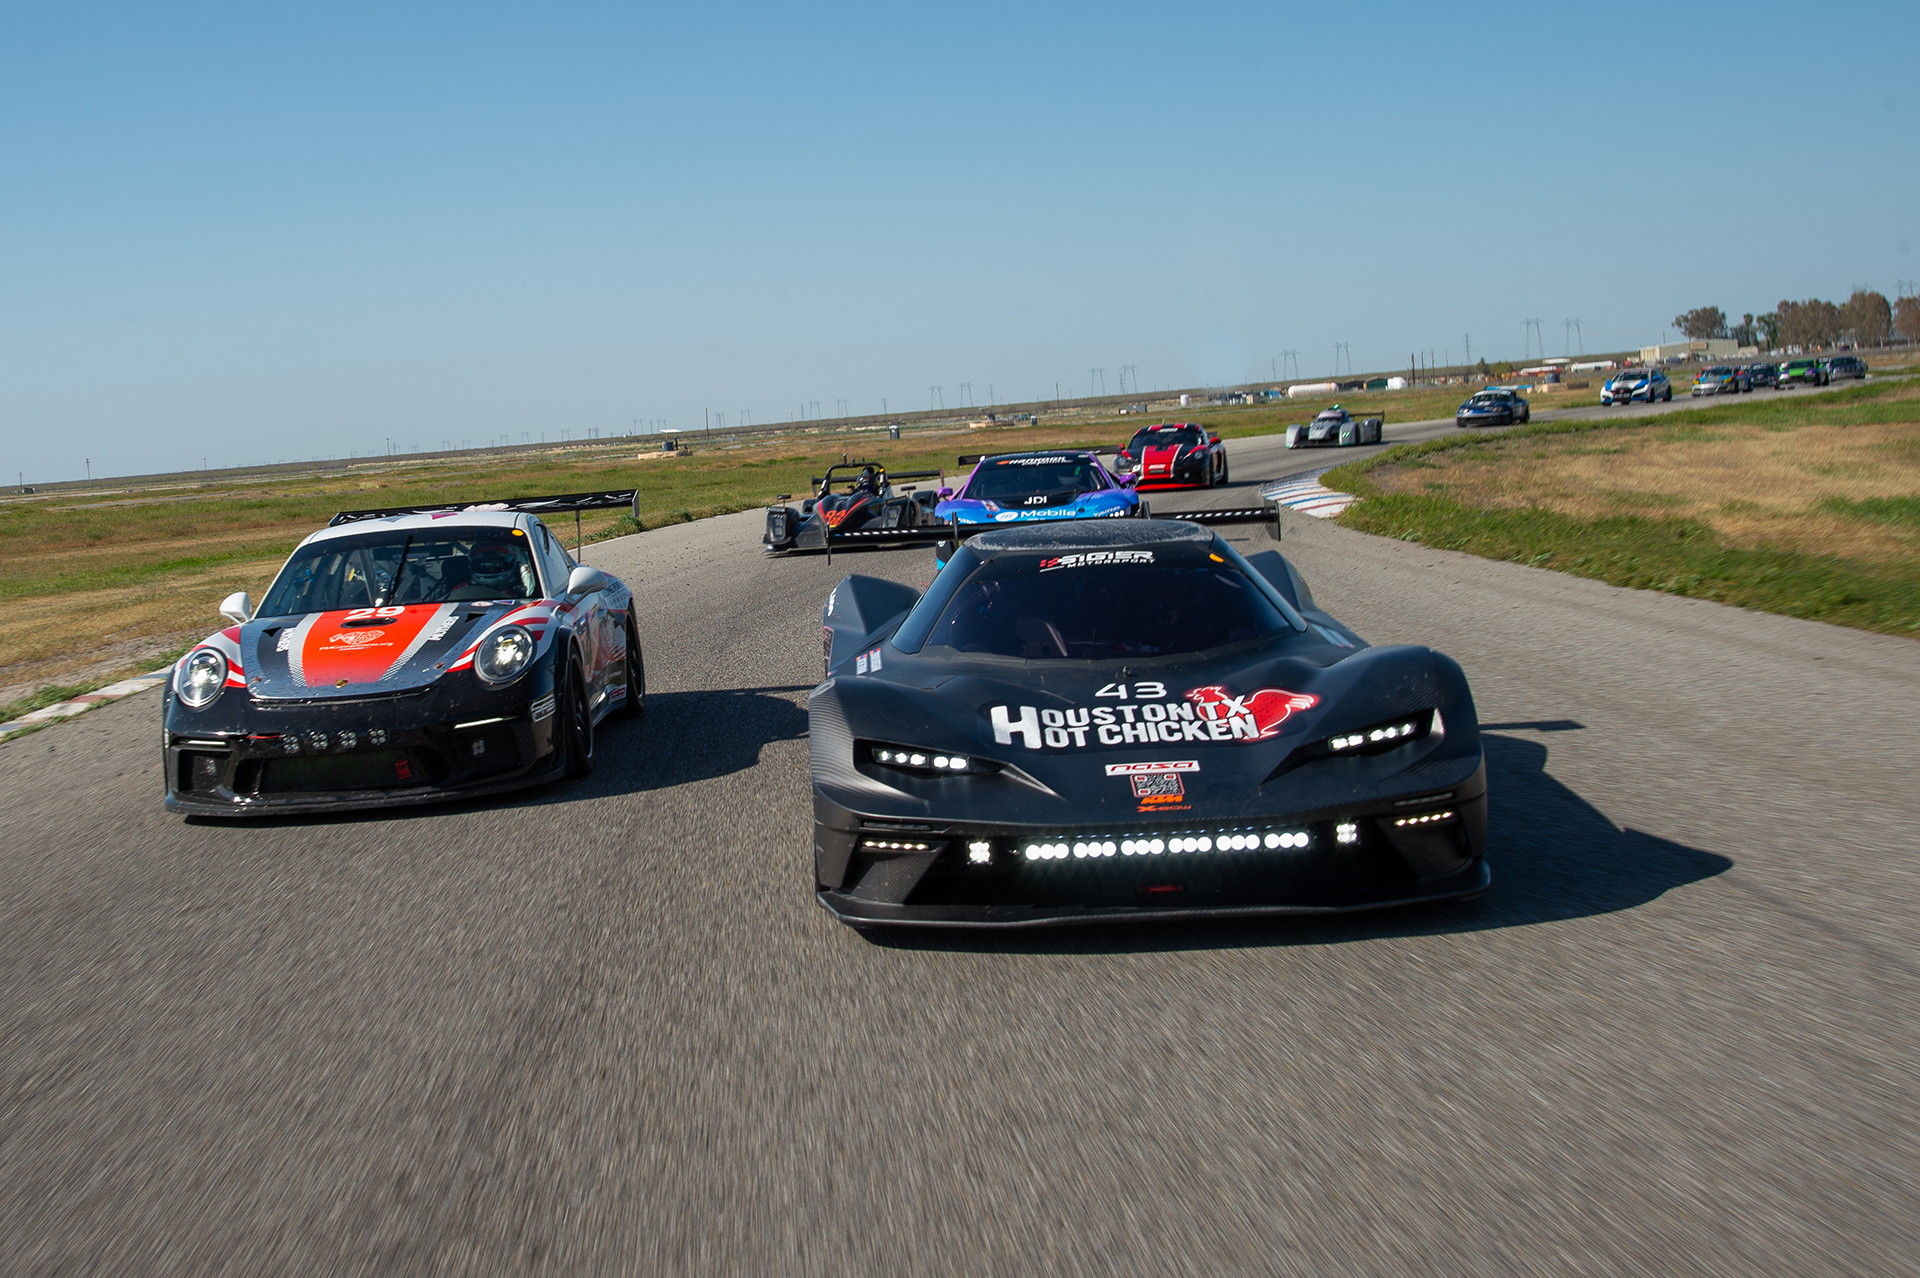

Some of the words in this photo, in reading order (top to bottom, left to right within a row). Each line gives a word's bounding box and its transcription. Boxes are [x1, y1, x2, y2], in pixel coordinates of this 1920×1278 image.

[1023, 495, 1048, 505] JDI
[1020, 509, 1076, 518] Mobile
[1066, 559, 1156, 568] MOTORSPORT
[343, 606, 405, 620] 29
[1094, 681, 1168, 700] 43
[1200, 695, 1251, 721] TX
[1097, 713, 1261, 745] CHICKEN
[1140, 794, 1184, 804] KTM
